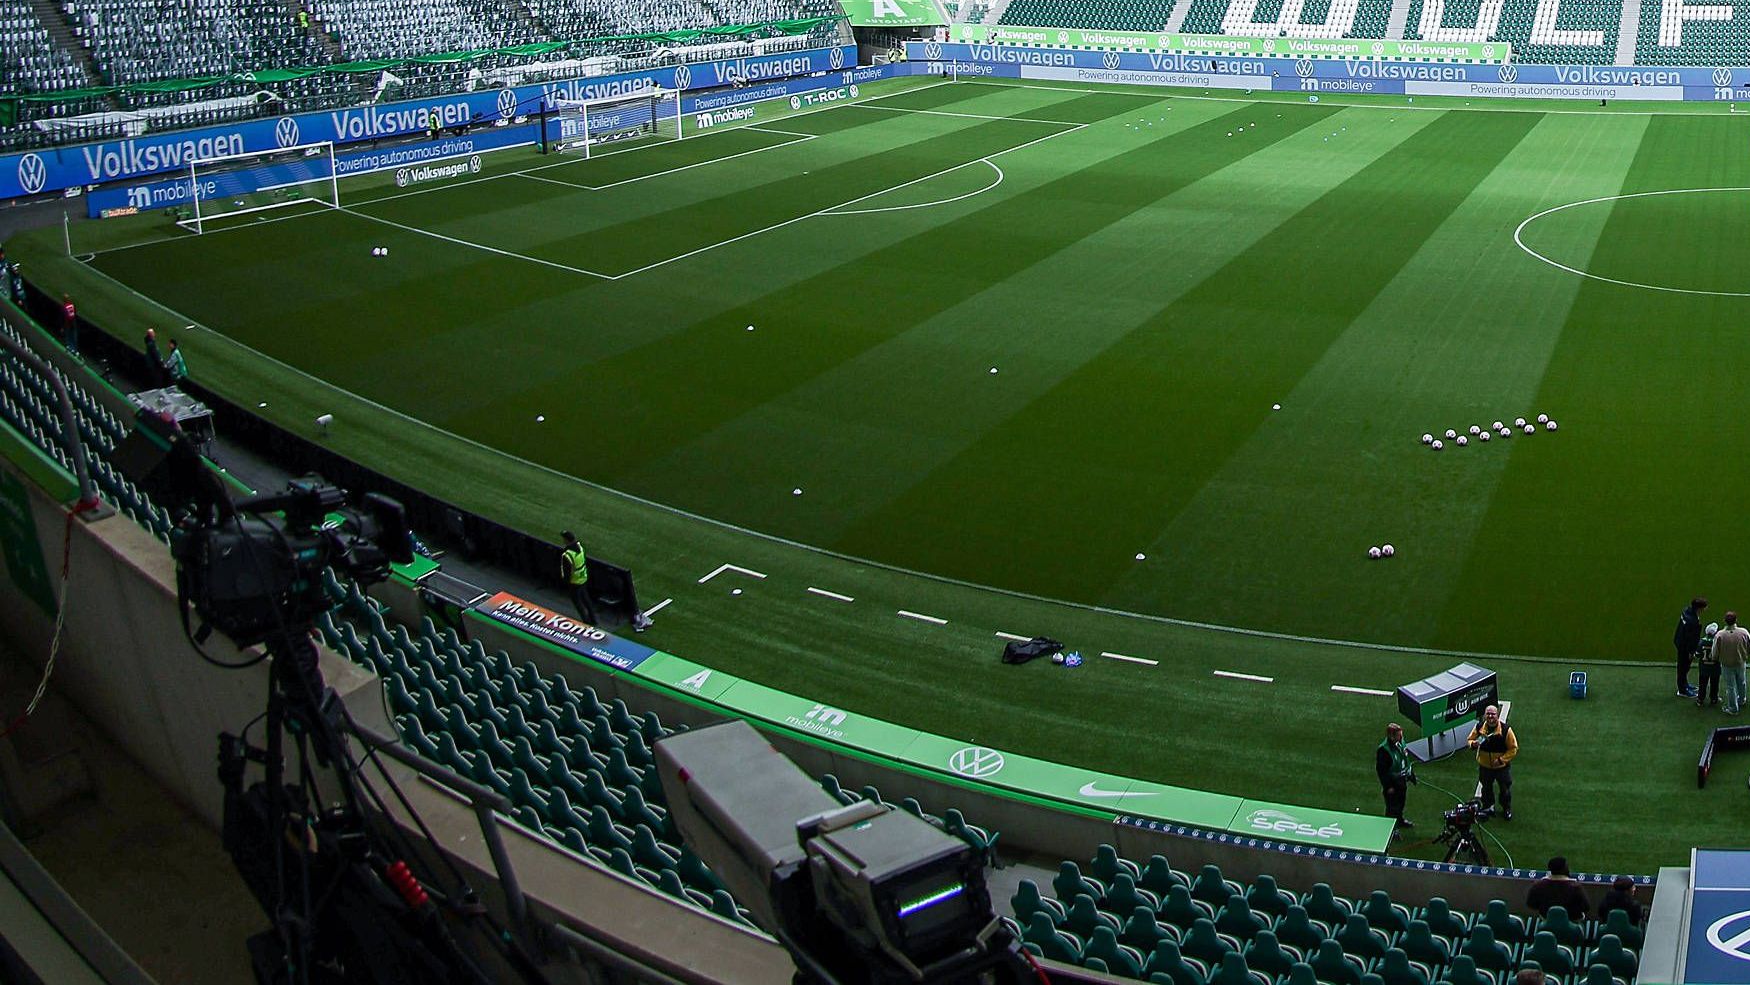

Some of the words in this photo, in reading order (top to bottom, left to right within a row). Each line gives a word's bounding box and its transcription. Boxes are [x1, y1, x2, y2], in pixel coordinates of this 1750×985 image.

[865, 17, 921, 25] AUTOSTADT
[1081, 32, 1147, 48] Volkswagen
[1183, 37, 1251, 52] Volkswagen
[1287, 40, 1359, 56] Volkswagen
[1397, 42, 1469, 57] Volkswagen
[969, 45, 1075, 67] Volkswagen
[1149, 55, 1265, 76] Volkswagen
[714, 54, 811, 84] Volkswagen
[852, 67, 883, 81] mobileye
[946, 62, 993, 76] mobileye
[1078, 69, 1118, 82] Powering
[1119, 73, 1176, 85] autonomous
[1177, 75, 1210, 89] driving
[1345, 60, 1466, 82] Volkswagen
[1555, 63, 1681, 86] Volkswagen
[542, 75, 653, 110] Volkswagen
[695, 95, 724, 111] Powering
[725, 88, 765, 106] autonomous
[766, 84, 787, 99] driving
[804, 88, 847, 105] T-ROC
[1321, 79, 1374, 94] mobileye
[1470, 83, 1516, 98] Powering
[1518, 85, 1577, 97] autonomous
[1579, 85, 1616, 99] driving
[331, 101, 471, 140] Volkswagen
[713, 107, 764, 123] mobileye
[83, 132, 244, 180] Volkswagen
[332, 158, 380, 174] Powering
[380, 147, 440, 167] autonomous
[441, 138, 474, 157] driving
[410, 162, 469, 184] Volkswagen
[153, 177, 217, 203] mobileye
[490, 609, 511, 623] Kann
[510, 616, 530, 629] alles.
[529, 621, 556, 636] Kostet
[555, 629, 580, 645] nichts.
[500, 599, 546, 622] Mein
[546, 613, 607, 641] Konto
[785, 714, 844, 738] mobileye
